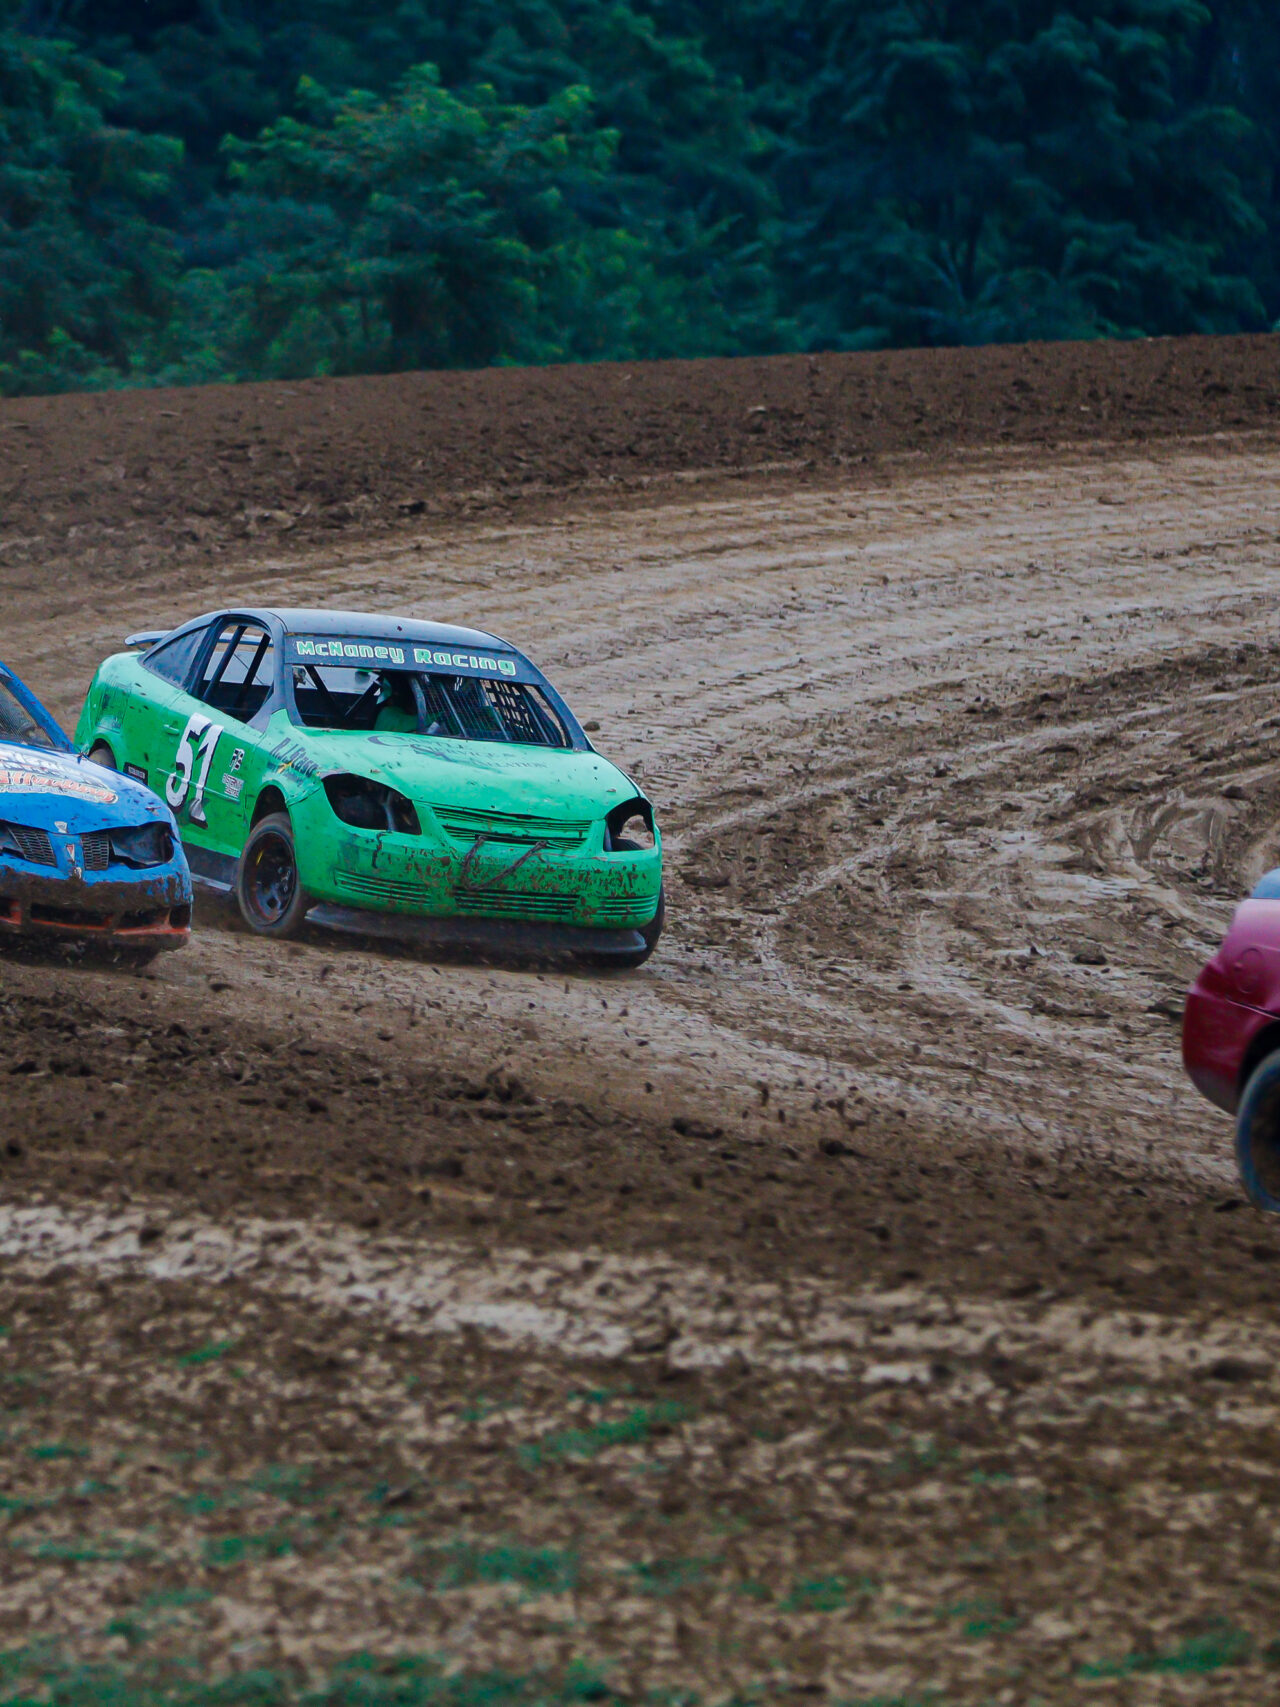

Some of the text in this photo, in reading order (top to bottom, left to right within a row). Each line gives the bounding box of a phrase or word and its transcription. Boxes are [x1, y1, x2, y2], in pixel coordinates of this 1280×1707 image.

[296, 640, 517, 676] McNaney Racing
[165, 712, 224, 829] 51
